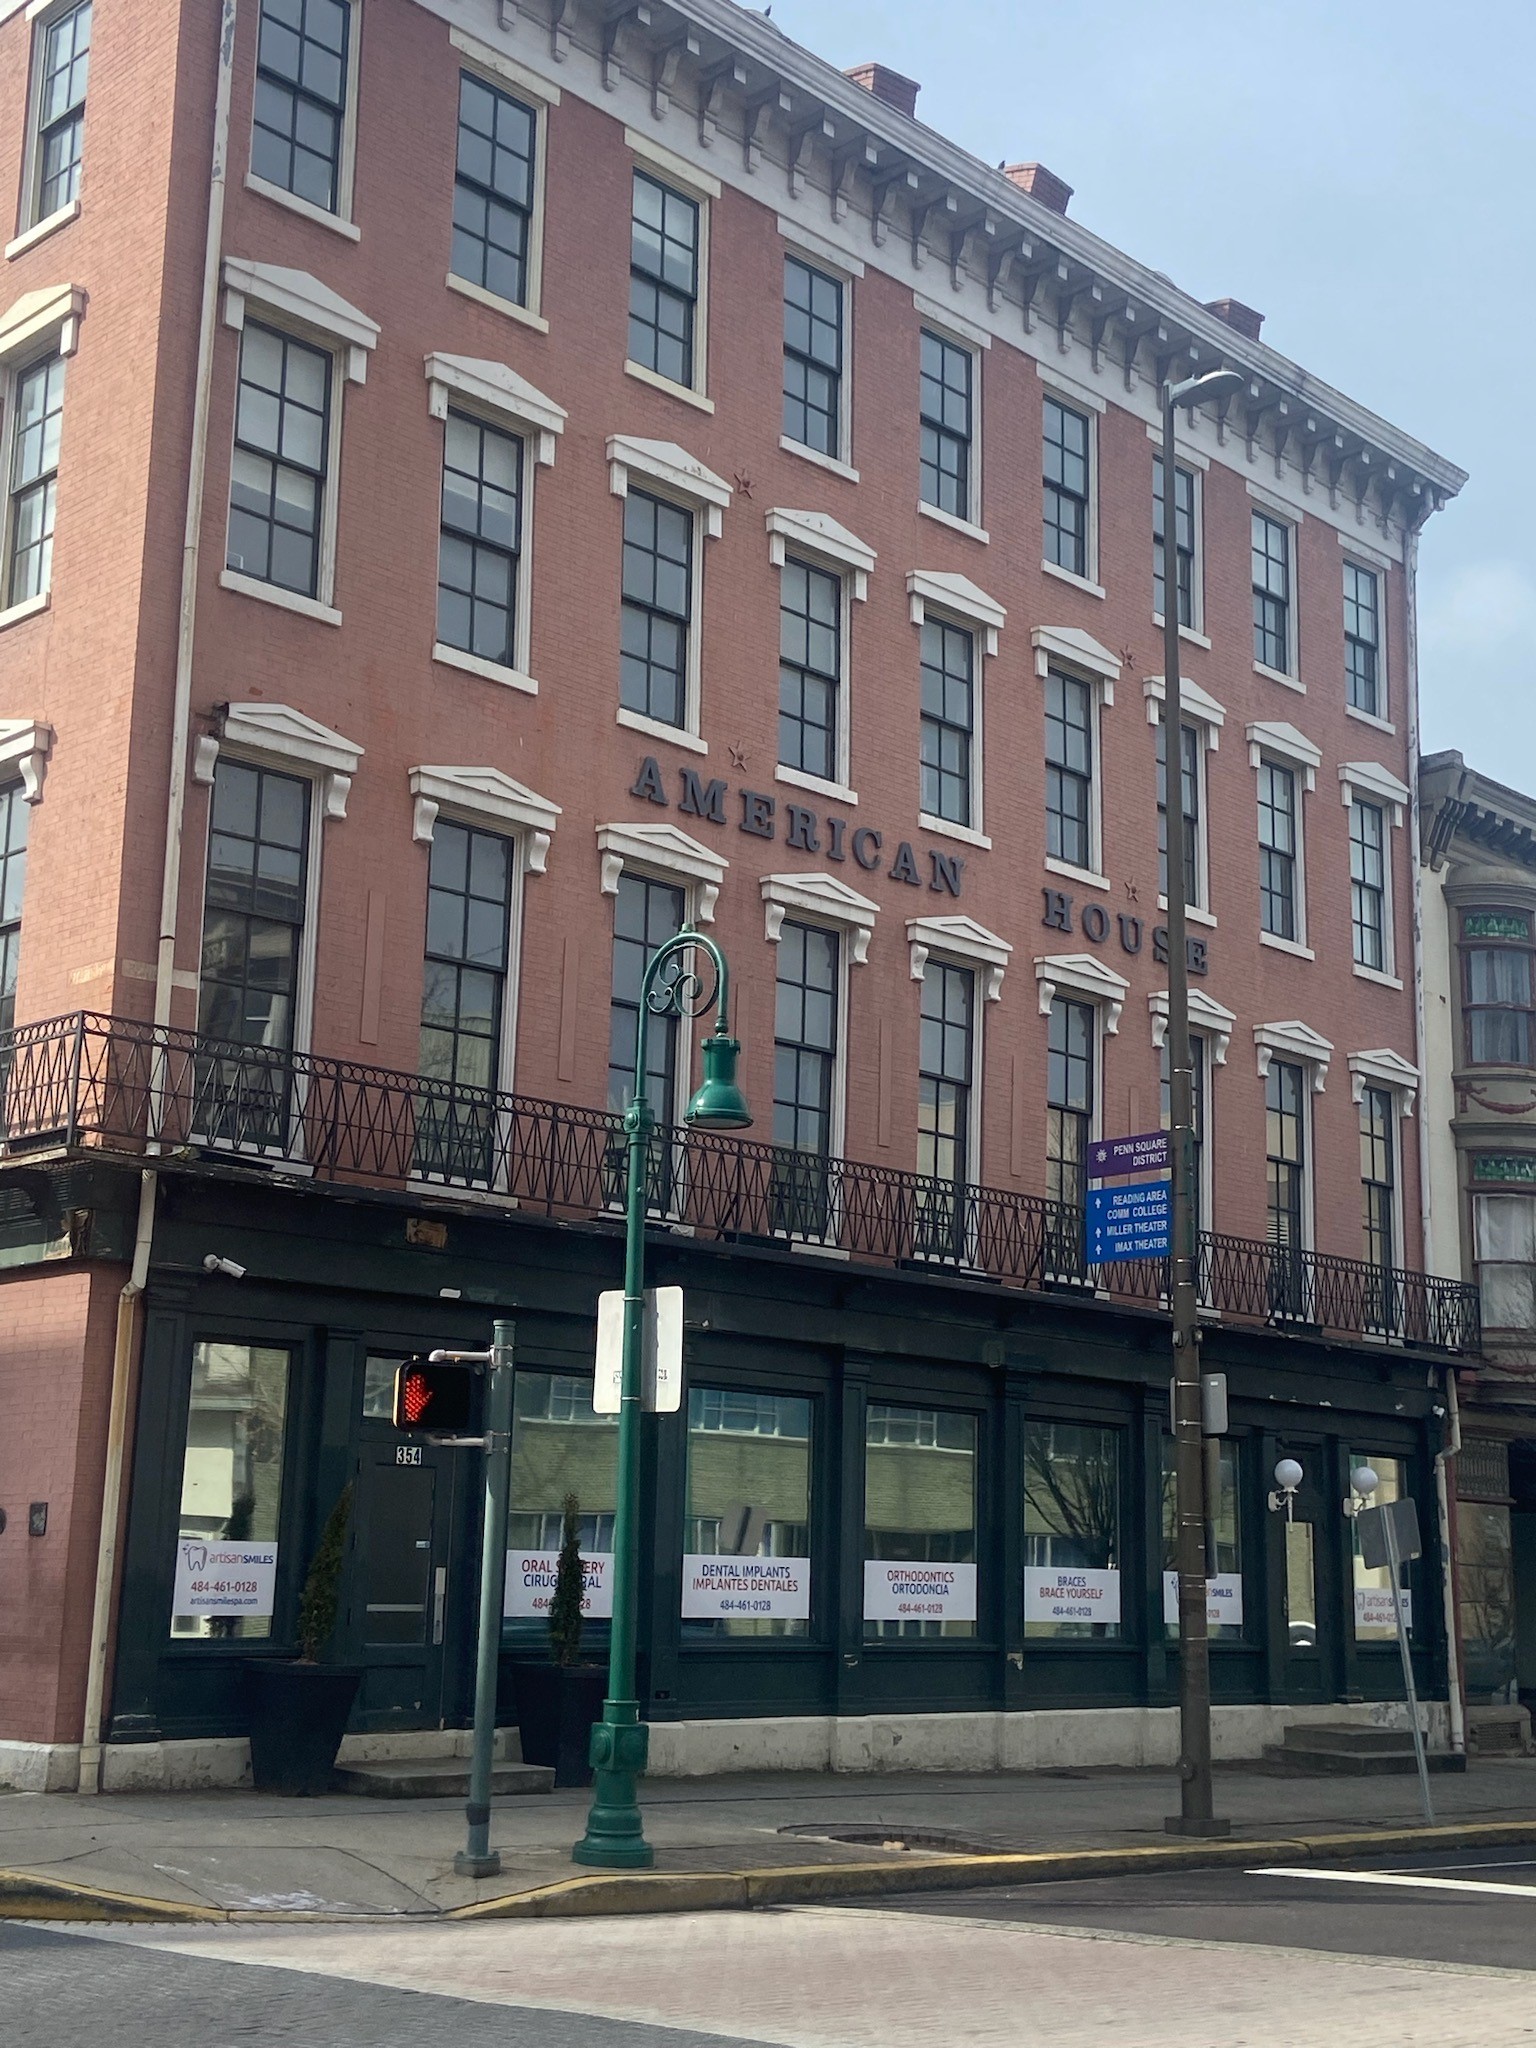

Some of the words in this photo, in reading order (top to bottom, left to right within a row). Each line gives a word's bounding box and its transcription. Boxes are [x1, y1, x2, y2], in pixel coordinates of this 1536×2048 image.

[630, 755, 966, 898] AMERICAN
[1113, 1143, 1135, 1156] PENN
[1135, 1138, 1168, 1153] SQUARE
[1132, 1151, 1168, 1166] DISTRICT
[1112, 1193, 1146, 1206] READING
[1146, 1189, 1168, 1201] AREA
[1106, 1208, 1130, 1220] COMM
[1132, 1204, 1168, 1217] COLLEGE
[1106, 1224, 1133, 1236] MILLER
[1134, 1220, 1168, 1233] THEATER
[1114, 1241, 1133, 1253] IMAX
[1134, 1237, 1168, 1250] THEATER
[397, 1447, 420, 1464] 354
[521, 1559, 553, 1573] ORAL
[702, 1564, 740, 1577] DENTAL
[742, 1565, 791, 1579] IMPLANTS
[887, 1570, 955, 1583] ORTHODONTICS
[1057, 1576, 1087, 1587] BRACES
[190, 1580, 258, 1593] 484-461-0128
[692, 1578, 749, 1591] IMPLANTES
[750, 1580, 799, 1592] DENTALES
[892, 1583, 949, 1595] ORTODONCIA
[1040, 1587, 1065, 1598] BRACE
[1066, 1588, 1103, 1599] YOURSELF
[189, 1597, 258, 1606] artisansmilespa.com
[720, 1600, 771, 1611] 484-461-0128
